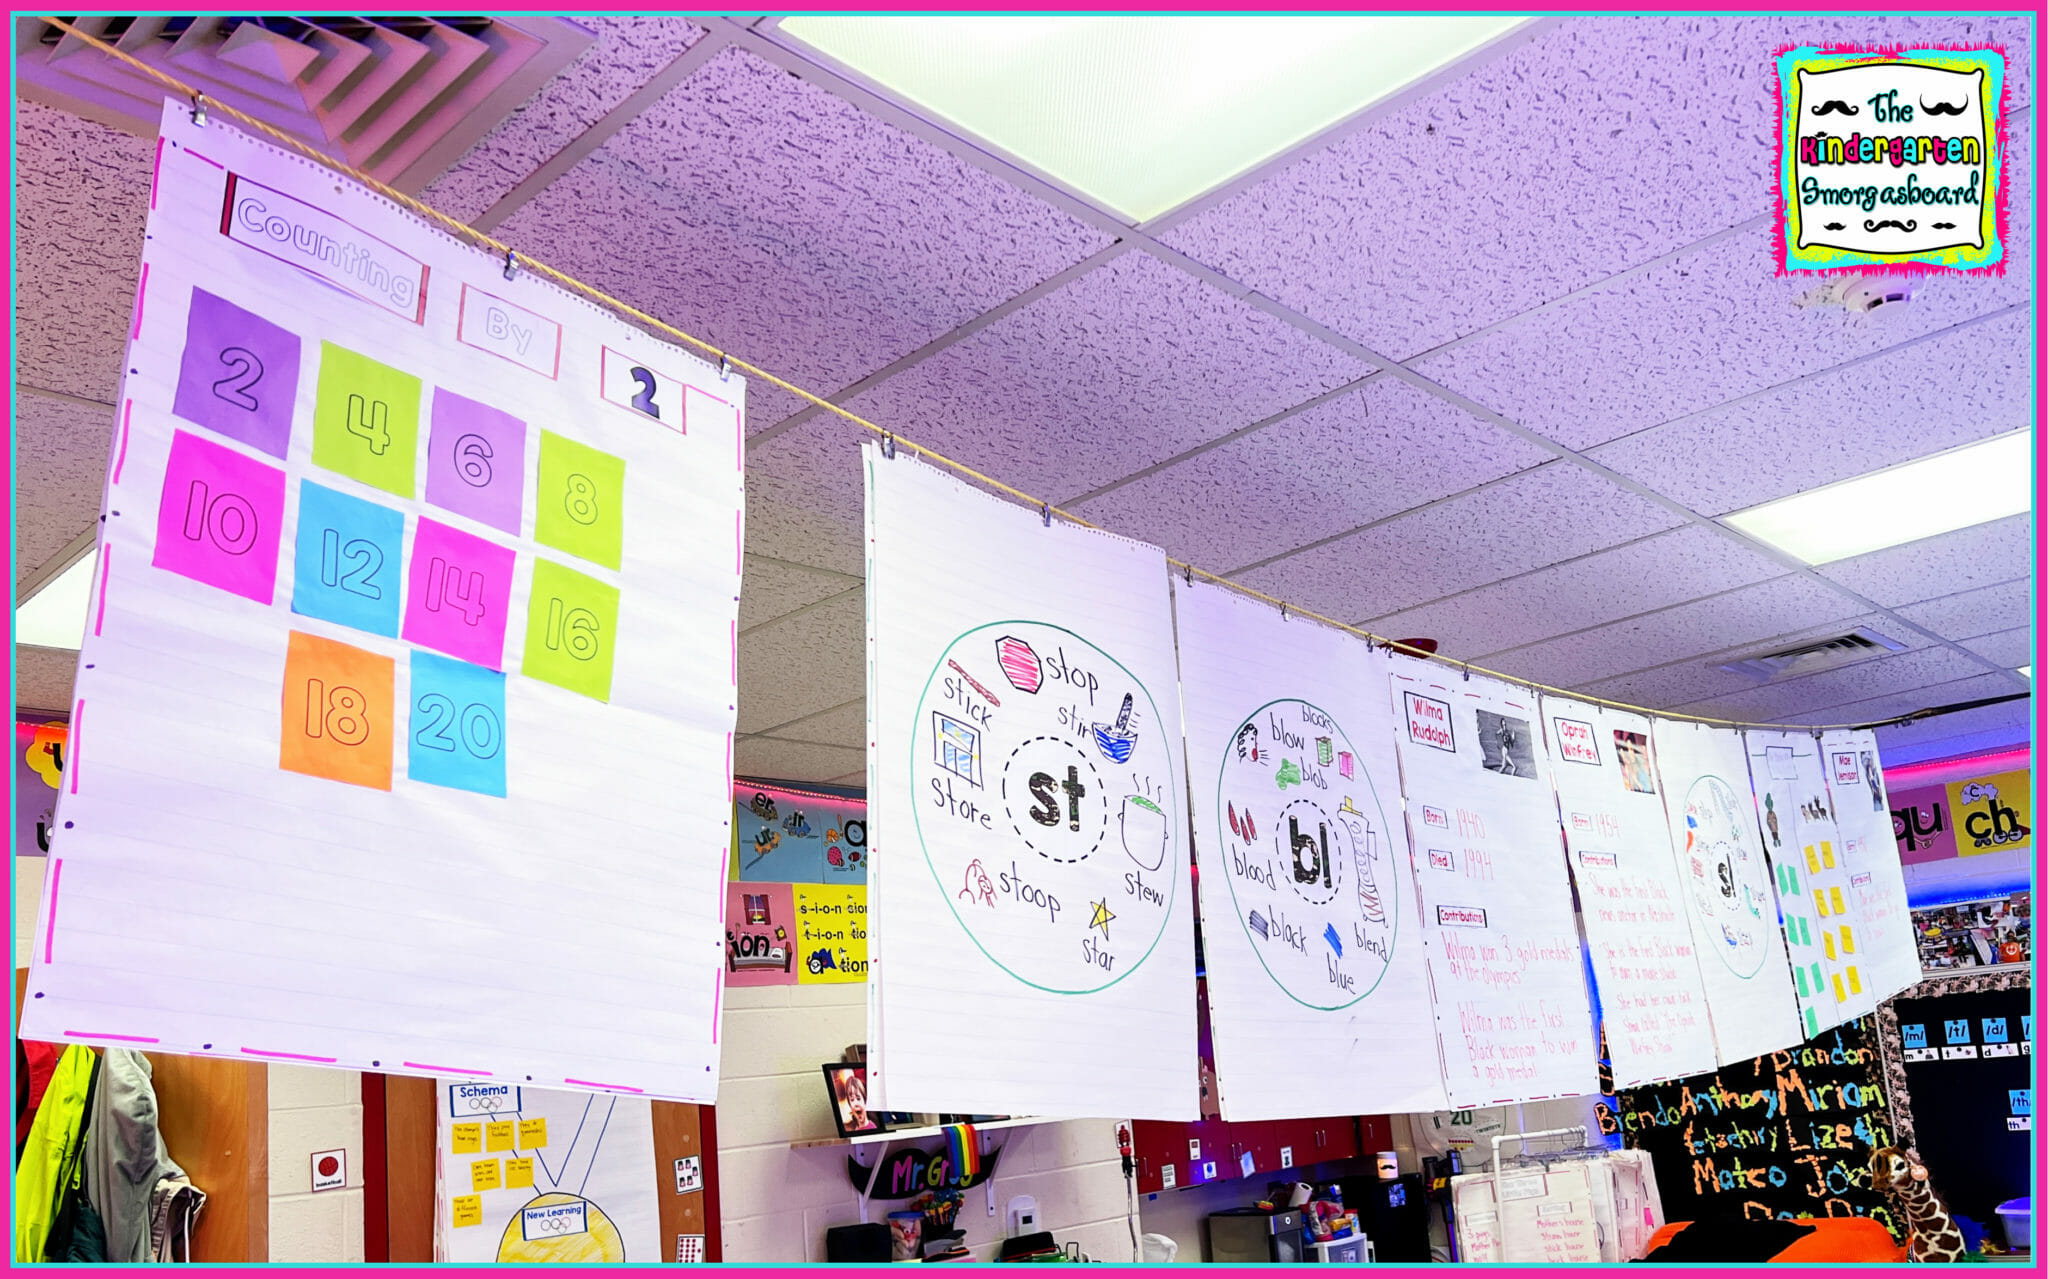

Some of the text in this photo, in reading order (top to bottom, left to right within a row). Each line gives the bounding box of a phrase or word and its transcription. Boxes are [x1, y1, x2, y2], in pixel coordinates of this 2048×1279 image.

[236, 195, 661, 418] Counting By 2
[211, 346, 599, 526] 2 4 6 8
[183, 479, 601, 661] 10 12 14 16
[1046, 646, 1099, 707] stop
[304, 678, 502, 760] 18 20
[943, 677, 993, 733] stick
[1057, 704, 1093, 739] stir
[1412, 696, 1444, 722] Wilma
[1269, 711, 1306, 751] blow
[1411, 720, 1452, 748] Rudolph
[1561, 721, 1589, 741] Oprah
[1299, 755, 1329, 791] blob
[1028, 765, 1086, 833] st
[1964, 798, 2019, 840] ch
[1456, 807, 1486, 841] 1940
[1231, 842, 1277, 892] blood
[1288, 814, 1333, 889] bl
[1431, 853, 1449, 868] Died
[999, 860, 1062, 924] stoop
[1124, 870, 1165, 908] stew
[1268, 903, 1309, 958] black
[1353, 921, 1389, 964] blend
[1082, 935, 1116, 972] star
[1326, 951, 1357, 996] blue
[460, 1084, 508, 1098] Schema
[526, 1204, 582, 1221] New Learning
